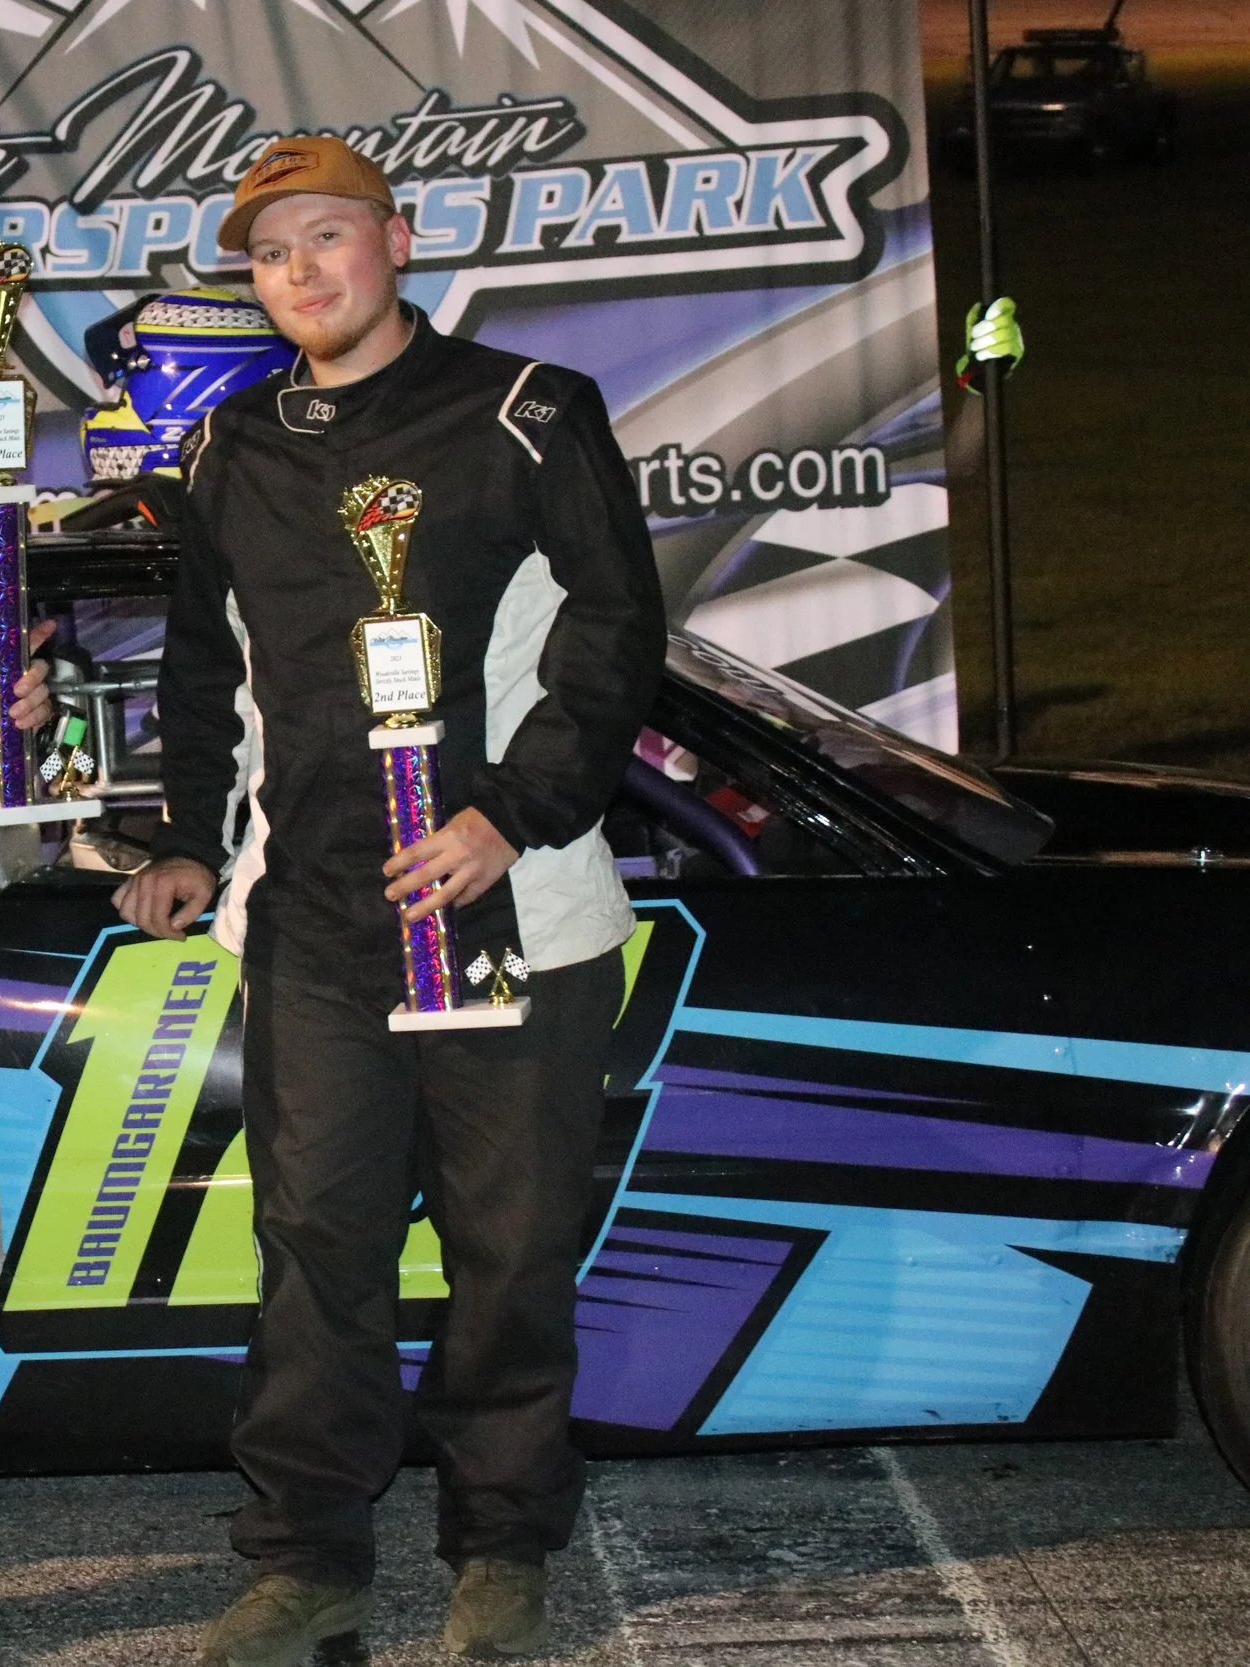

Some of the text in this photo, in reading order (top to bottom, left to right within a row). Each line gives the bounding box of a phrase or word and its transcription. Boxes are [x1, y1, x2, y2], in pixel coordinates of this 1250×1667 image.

[54, 48, 583, 208] Montain
[496, 145, 827, 255] PARK
[514, 401, 556, 423] K1
[638, 445, 887, 508] rts.com
[373, 689, 426, 703] 2nd Place
[66, 958, 219, 1287] BAUMGARDNER
